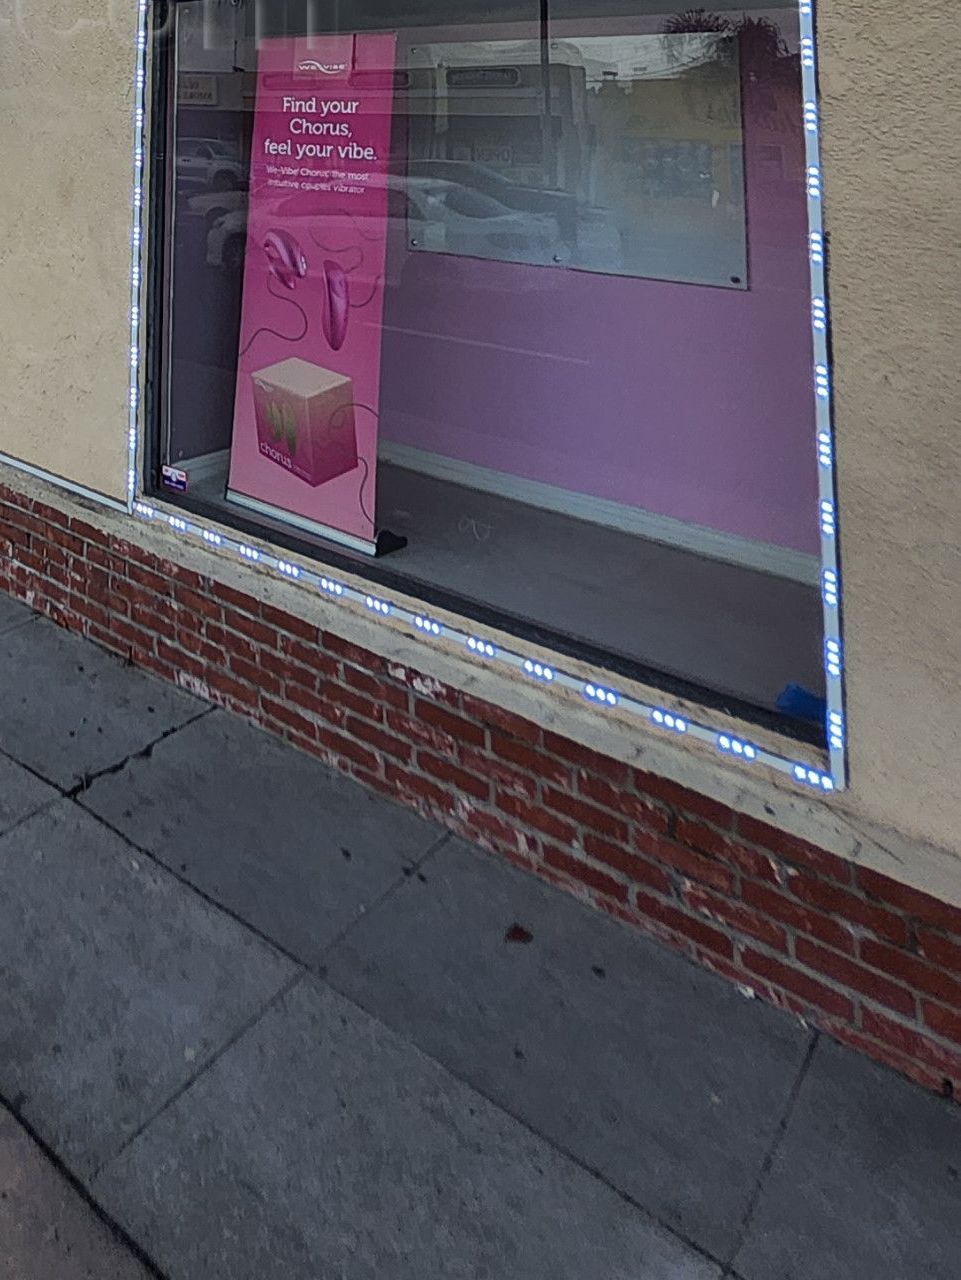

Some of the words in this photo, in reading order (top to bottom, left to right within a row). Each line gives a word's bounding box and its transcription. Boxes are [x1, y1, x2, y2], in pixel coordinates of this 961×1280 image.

[283, 97, 317, 113] Find
[320, 100, 359, 117] your
[290, 118, 352, 138] Chorus,
[264, 138, 292, 155] feel
[295, 143, 334, 160] your
[338, 142, 377, 160] vibe.
[260, 442, 293, 469] chorus
